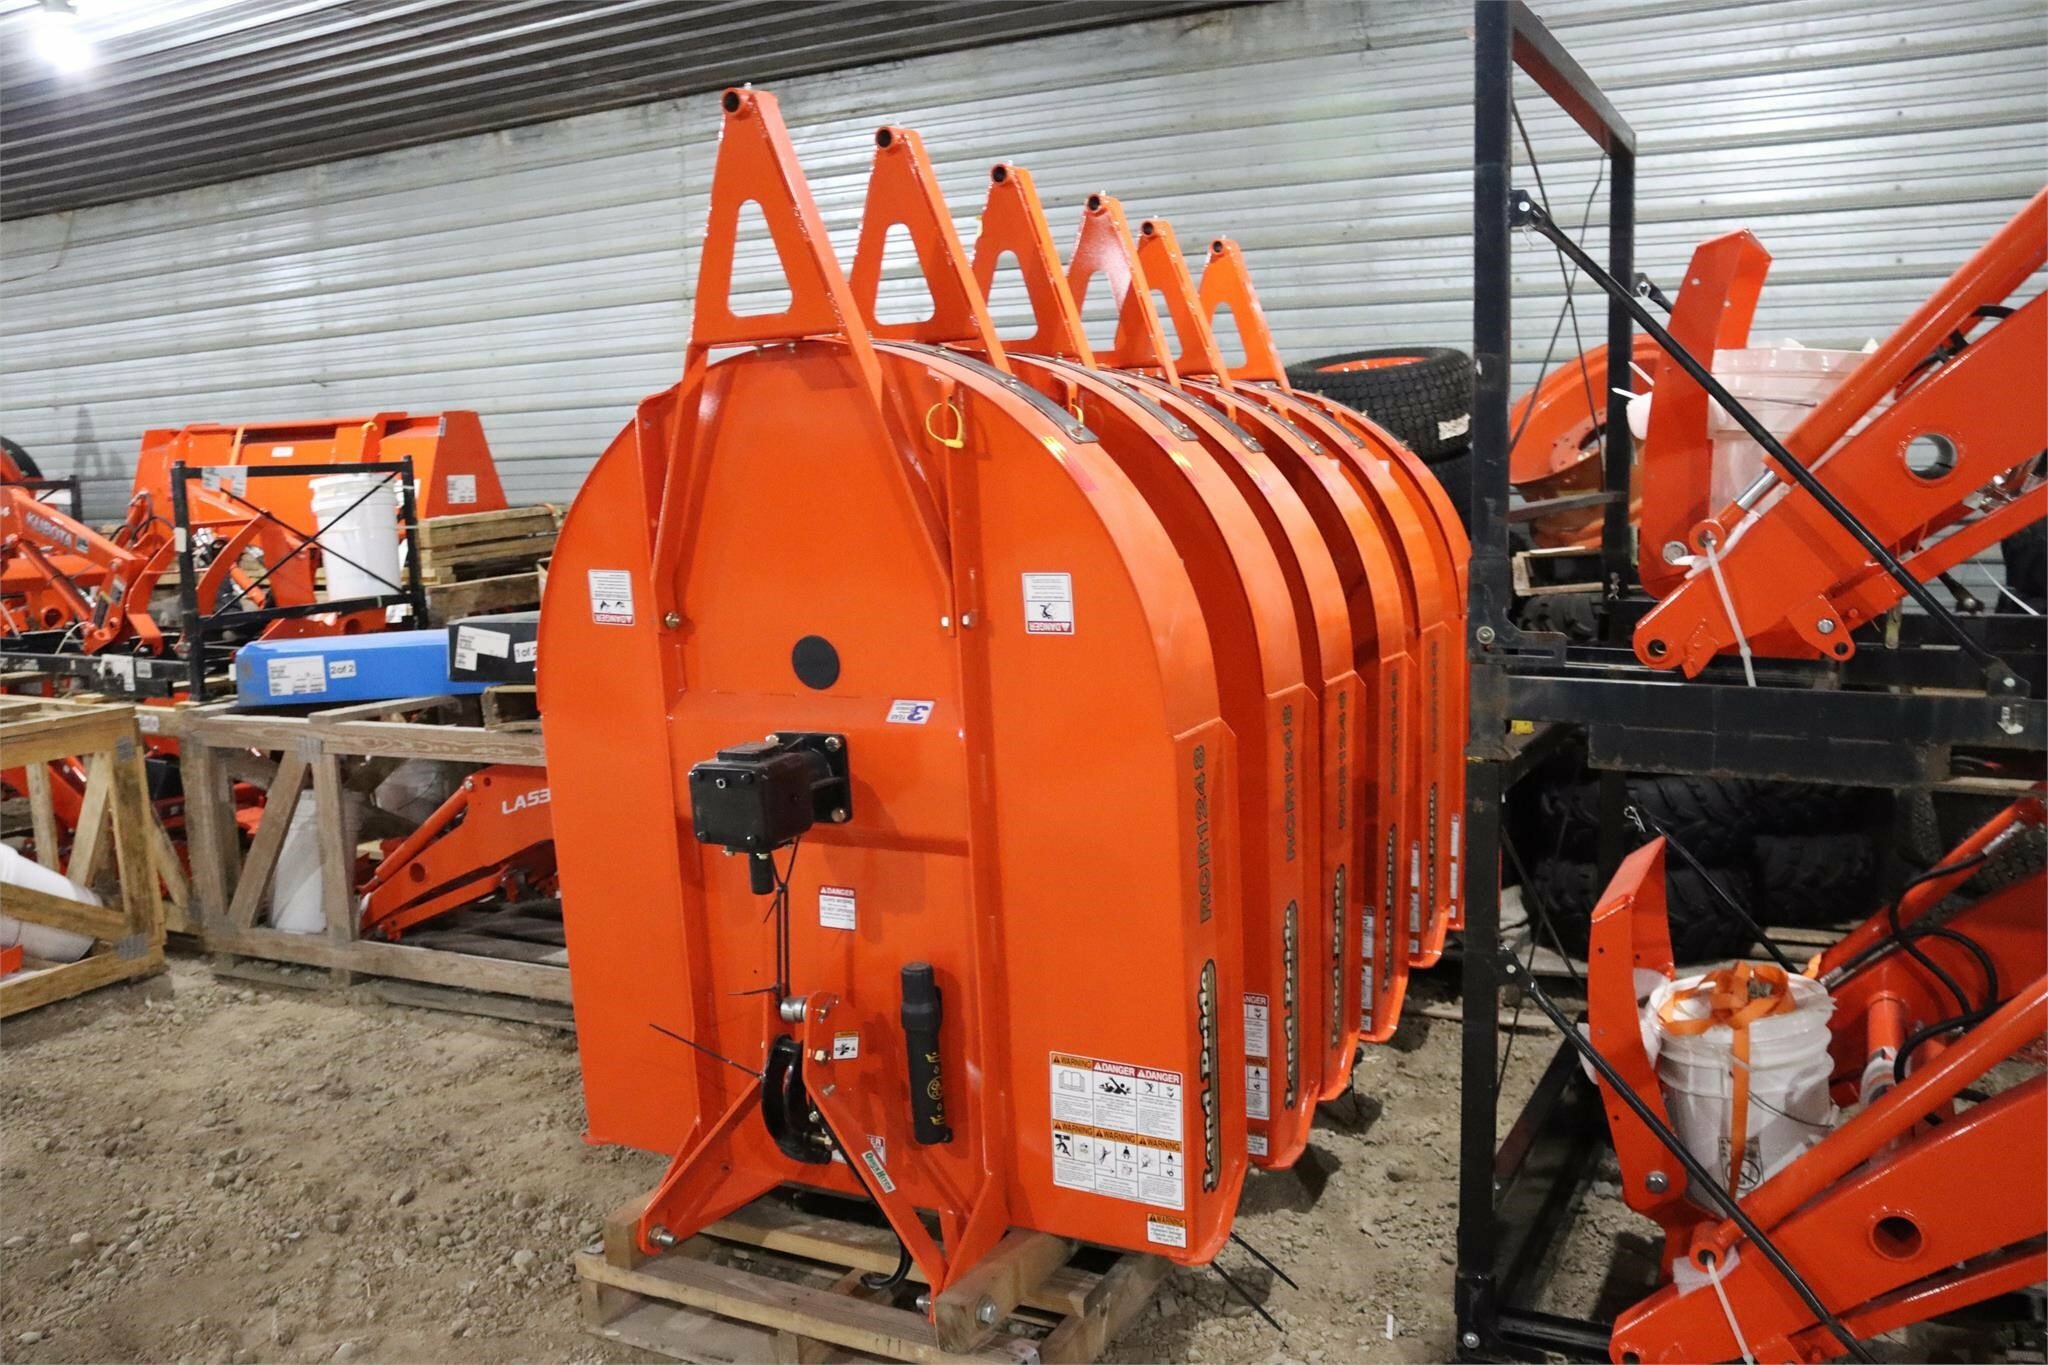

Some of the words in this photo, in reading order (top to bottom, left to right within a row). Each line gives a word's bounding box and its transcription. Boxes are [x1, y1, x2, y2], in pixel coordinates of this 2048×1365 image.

[1030, 622, 1062, 632] DANGER
[331, 666, 336, 675] 2
[337, 665, 346, 674] of
[349, 664, 354, 673] 2
[907, 705, 929, 721] 3
[1193, 744, 1213, 923] RCR1248
[827, 888, 855, 897] DANGER
[1199, 969, 1212, 1081] Pride
[1061, 1057, 1092, 1069] WARNING
[1102, 1063, 1135, 1075] DANGER
[1145, 1069, 1180, 1083] DANGER
[1062, 1123, 1094, 1136] WARNING
[1104, 1131, 1136, 1144] WARNING
[1201, 1089, 1217, 1192] Land
[1147, 1140, 1180, 1152] WARNING
